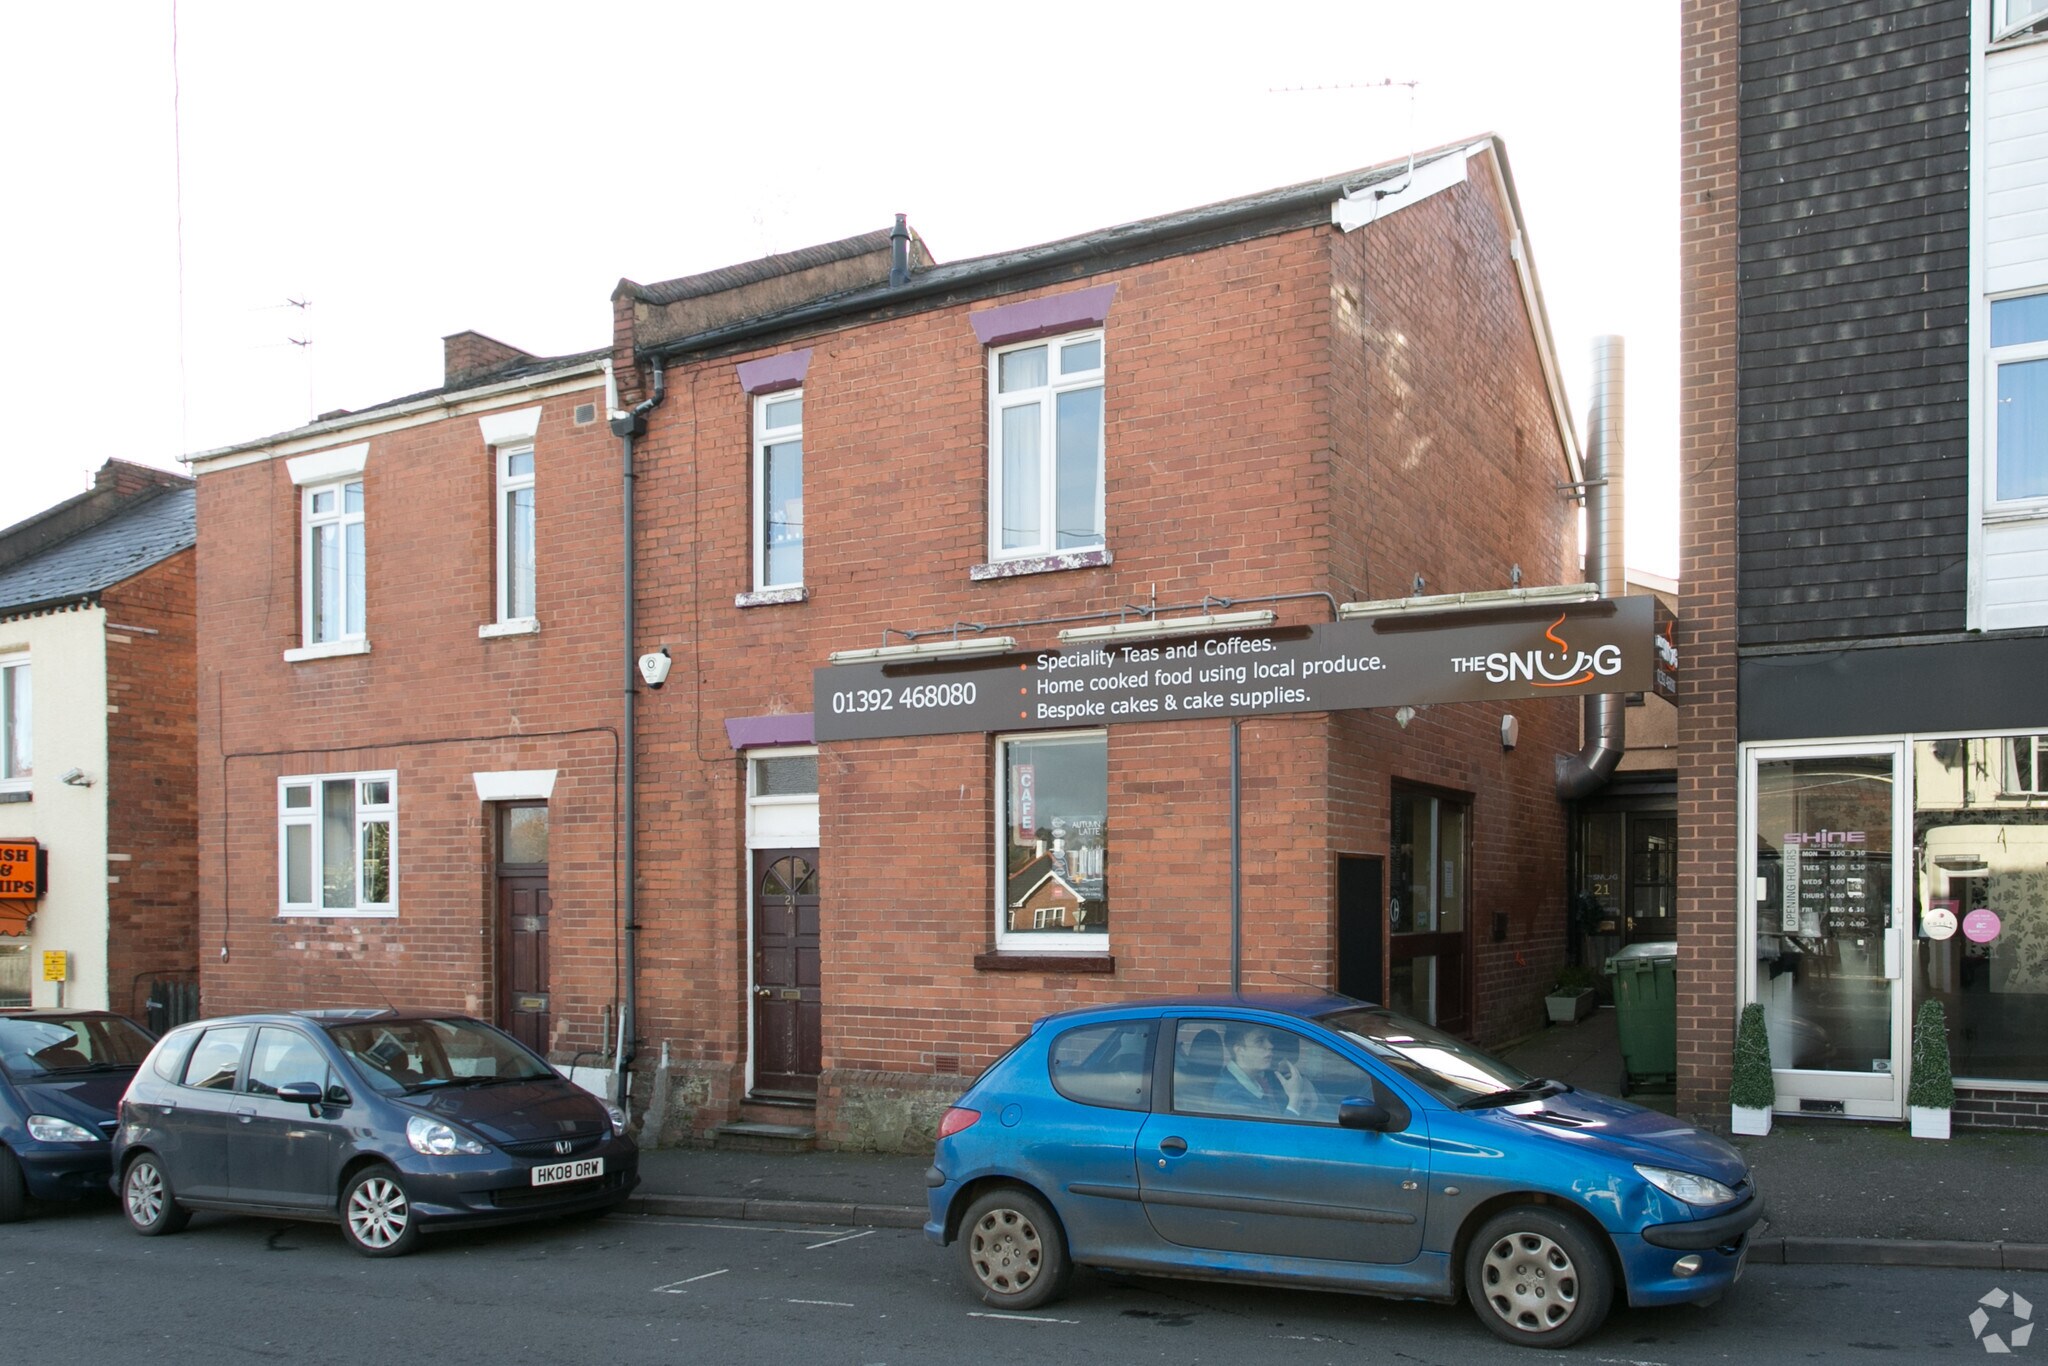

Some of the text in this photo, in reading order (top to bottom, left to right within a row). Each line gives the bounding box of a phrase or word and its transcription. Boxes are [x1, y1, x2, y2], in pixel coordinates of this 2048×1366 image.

[1037, 637, 1277, 672] Speciality Teas and Coffees.
[1451, 656, 1486, 672] THE
[1486, 644, 1622, 683] SNUG
[1037, 655, 1387, 695] Home cooked food using local produce.
[832, 682, 976, 714] 01392 468080
[1037, 686, 1311, 720] Bespoke cakes & cake supplies.
[1021, 773, 1032, 829] CAFE
[1072, 820, 1101, 828] AUTUMN
[1079, 827, 1100, 836] LATTE
[1594, 883, 1610, 895] 21
[1786, 849, 1796, 926] OPENING HOURS
[538, 1160, 599, 1183] HK08 ORW
